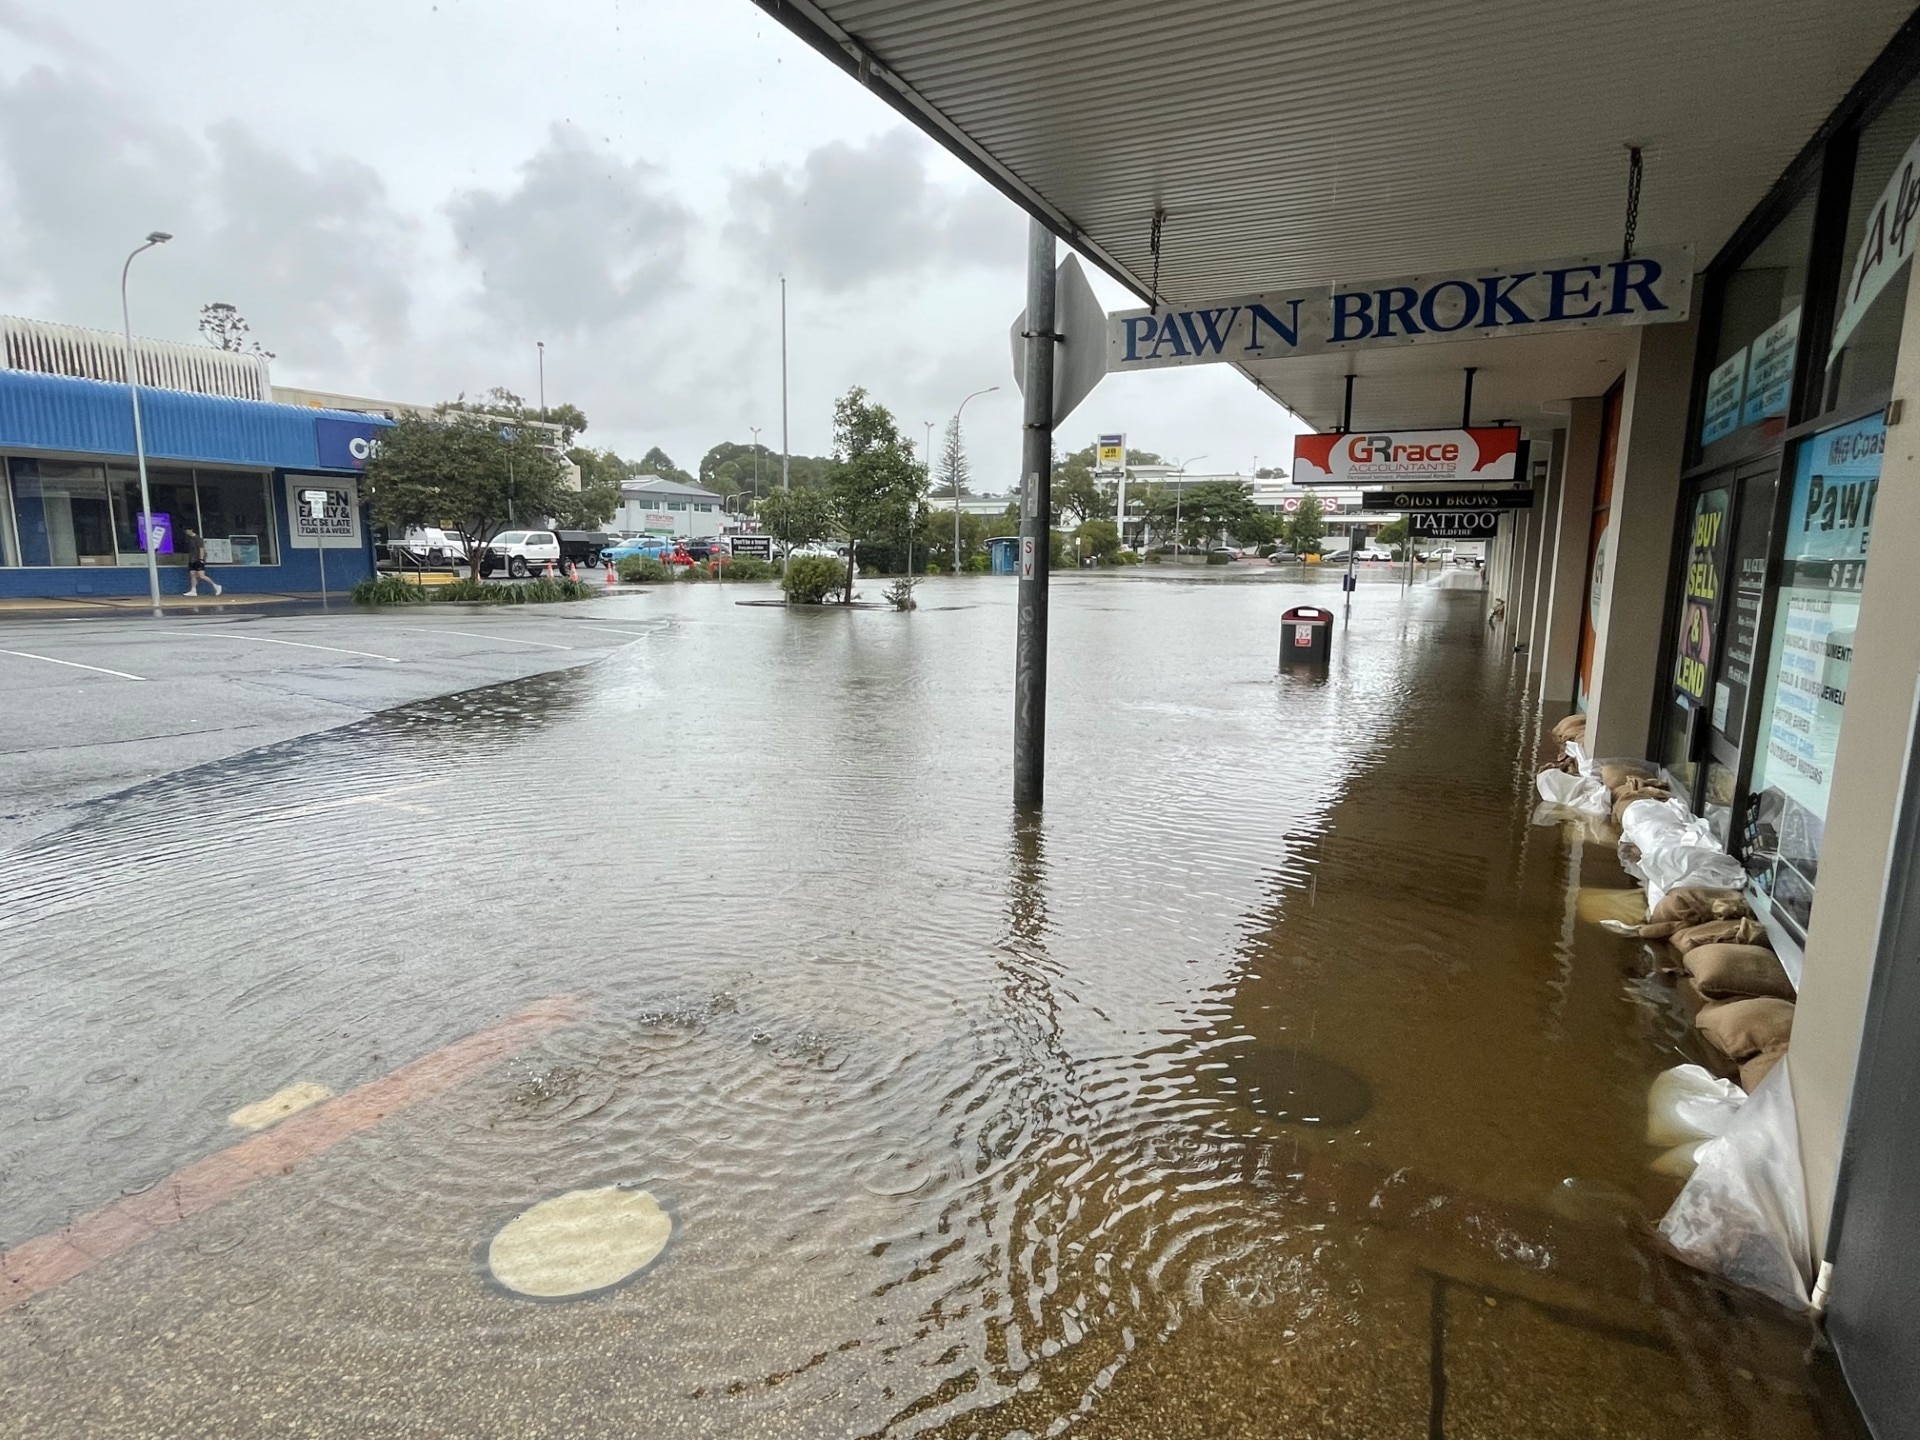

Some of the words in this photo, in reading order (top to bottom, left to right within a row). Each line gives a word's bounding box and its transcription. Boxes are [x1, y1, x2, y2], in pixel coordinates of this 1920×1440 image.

[1120, 299, 1305, 362] PAWN
[1326, 258, 1669, 342] BROKER
[1349, 462, 1457, 472] ACCOUNTANTS
[1410, 495, 1440, 507] JUST
[1447, 494, 1498, 506] BROWS
[340, 507, 350, 518] &
[331, 519, 351, 528] LATE
[1412, 512, 1495, 529] TATTOO
[332, 527, 352, 535] WEEK
[1431, 528, 1472, 536] WILDFIRE
[1695, 512, 1722, 547] BUY
[1688, 563, 1715, 600] SELL
[1690, 608, 1701, 642] &
[1676, 656, 1706, 698] LEND
